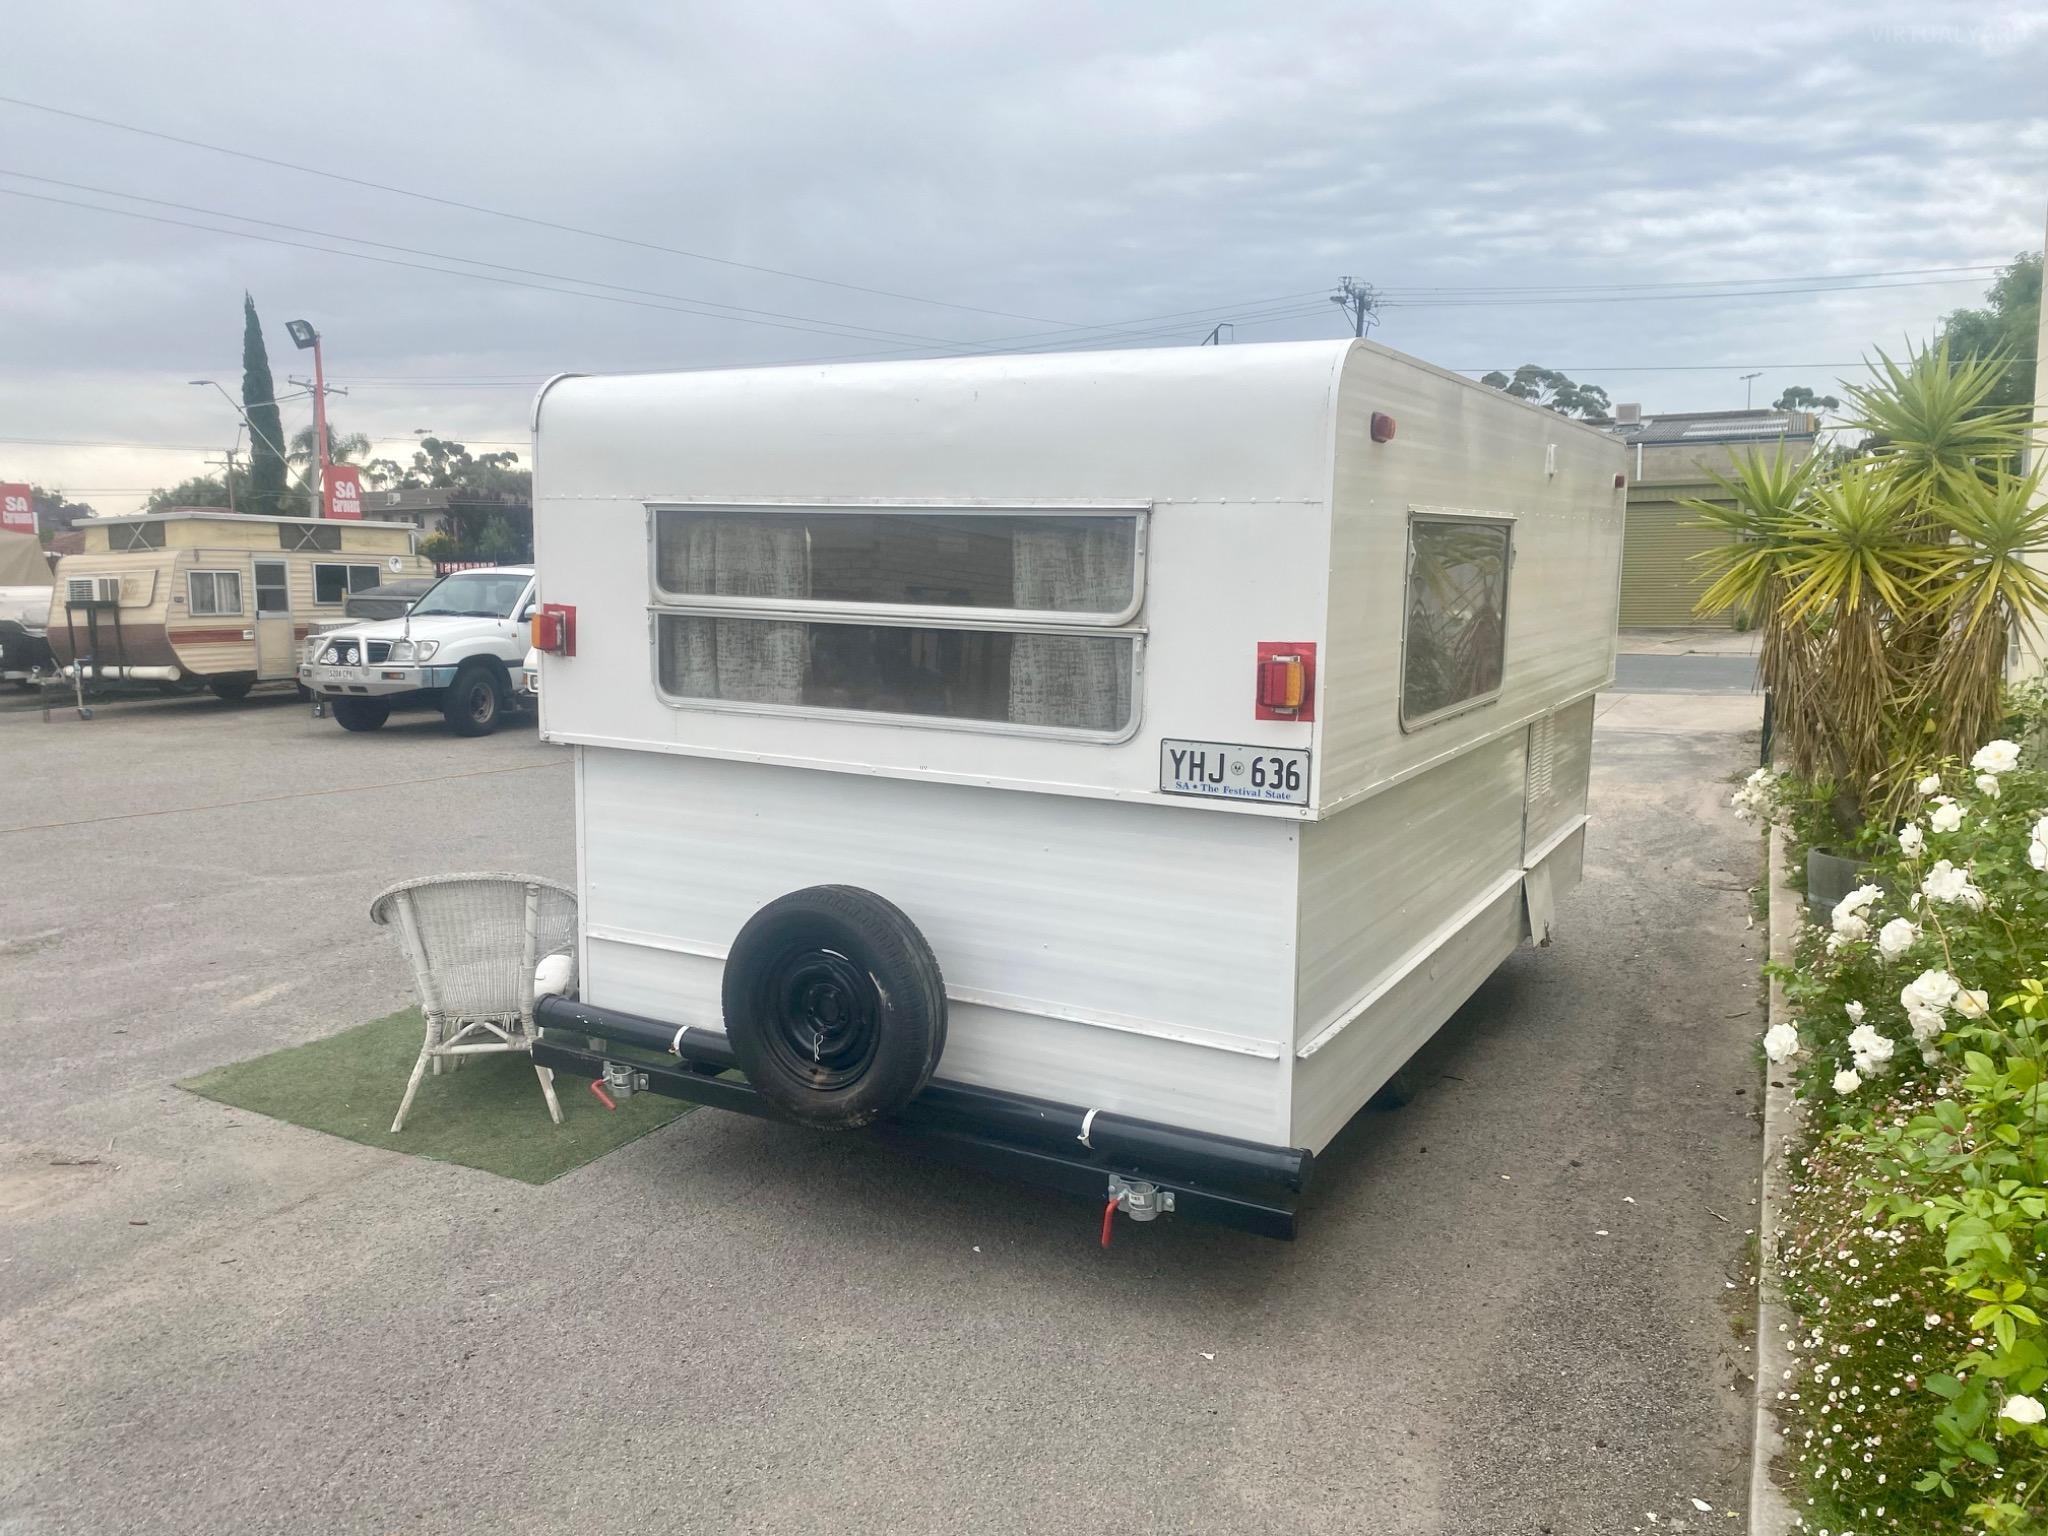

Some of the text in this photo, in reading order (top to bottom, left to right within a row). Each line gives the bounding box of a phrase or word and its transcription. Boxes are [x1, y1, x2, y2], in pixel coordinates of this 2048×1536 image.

[335, 481, 356, 498] SA
[5, 496, 28, 511] SA
[1170, 749, 1300, 791] YHJ 636
[1175, 780, 1291, 800] SA The Festival State
